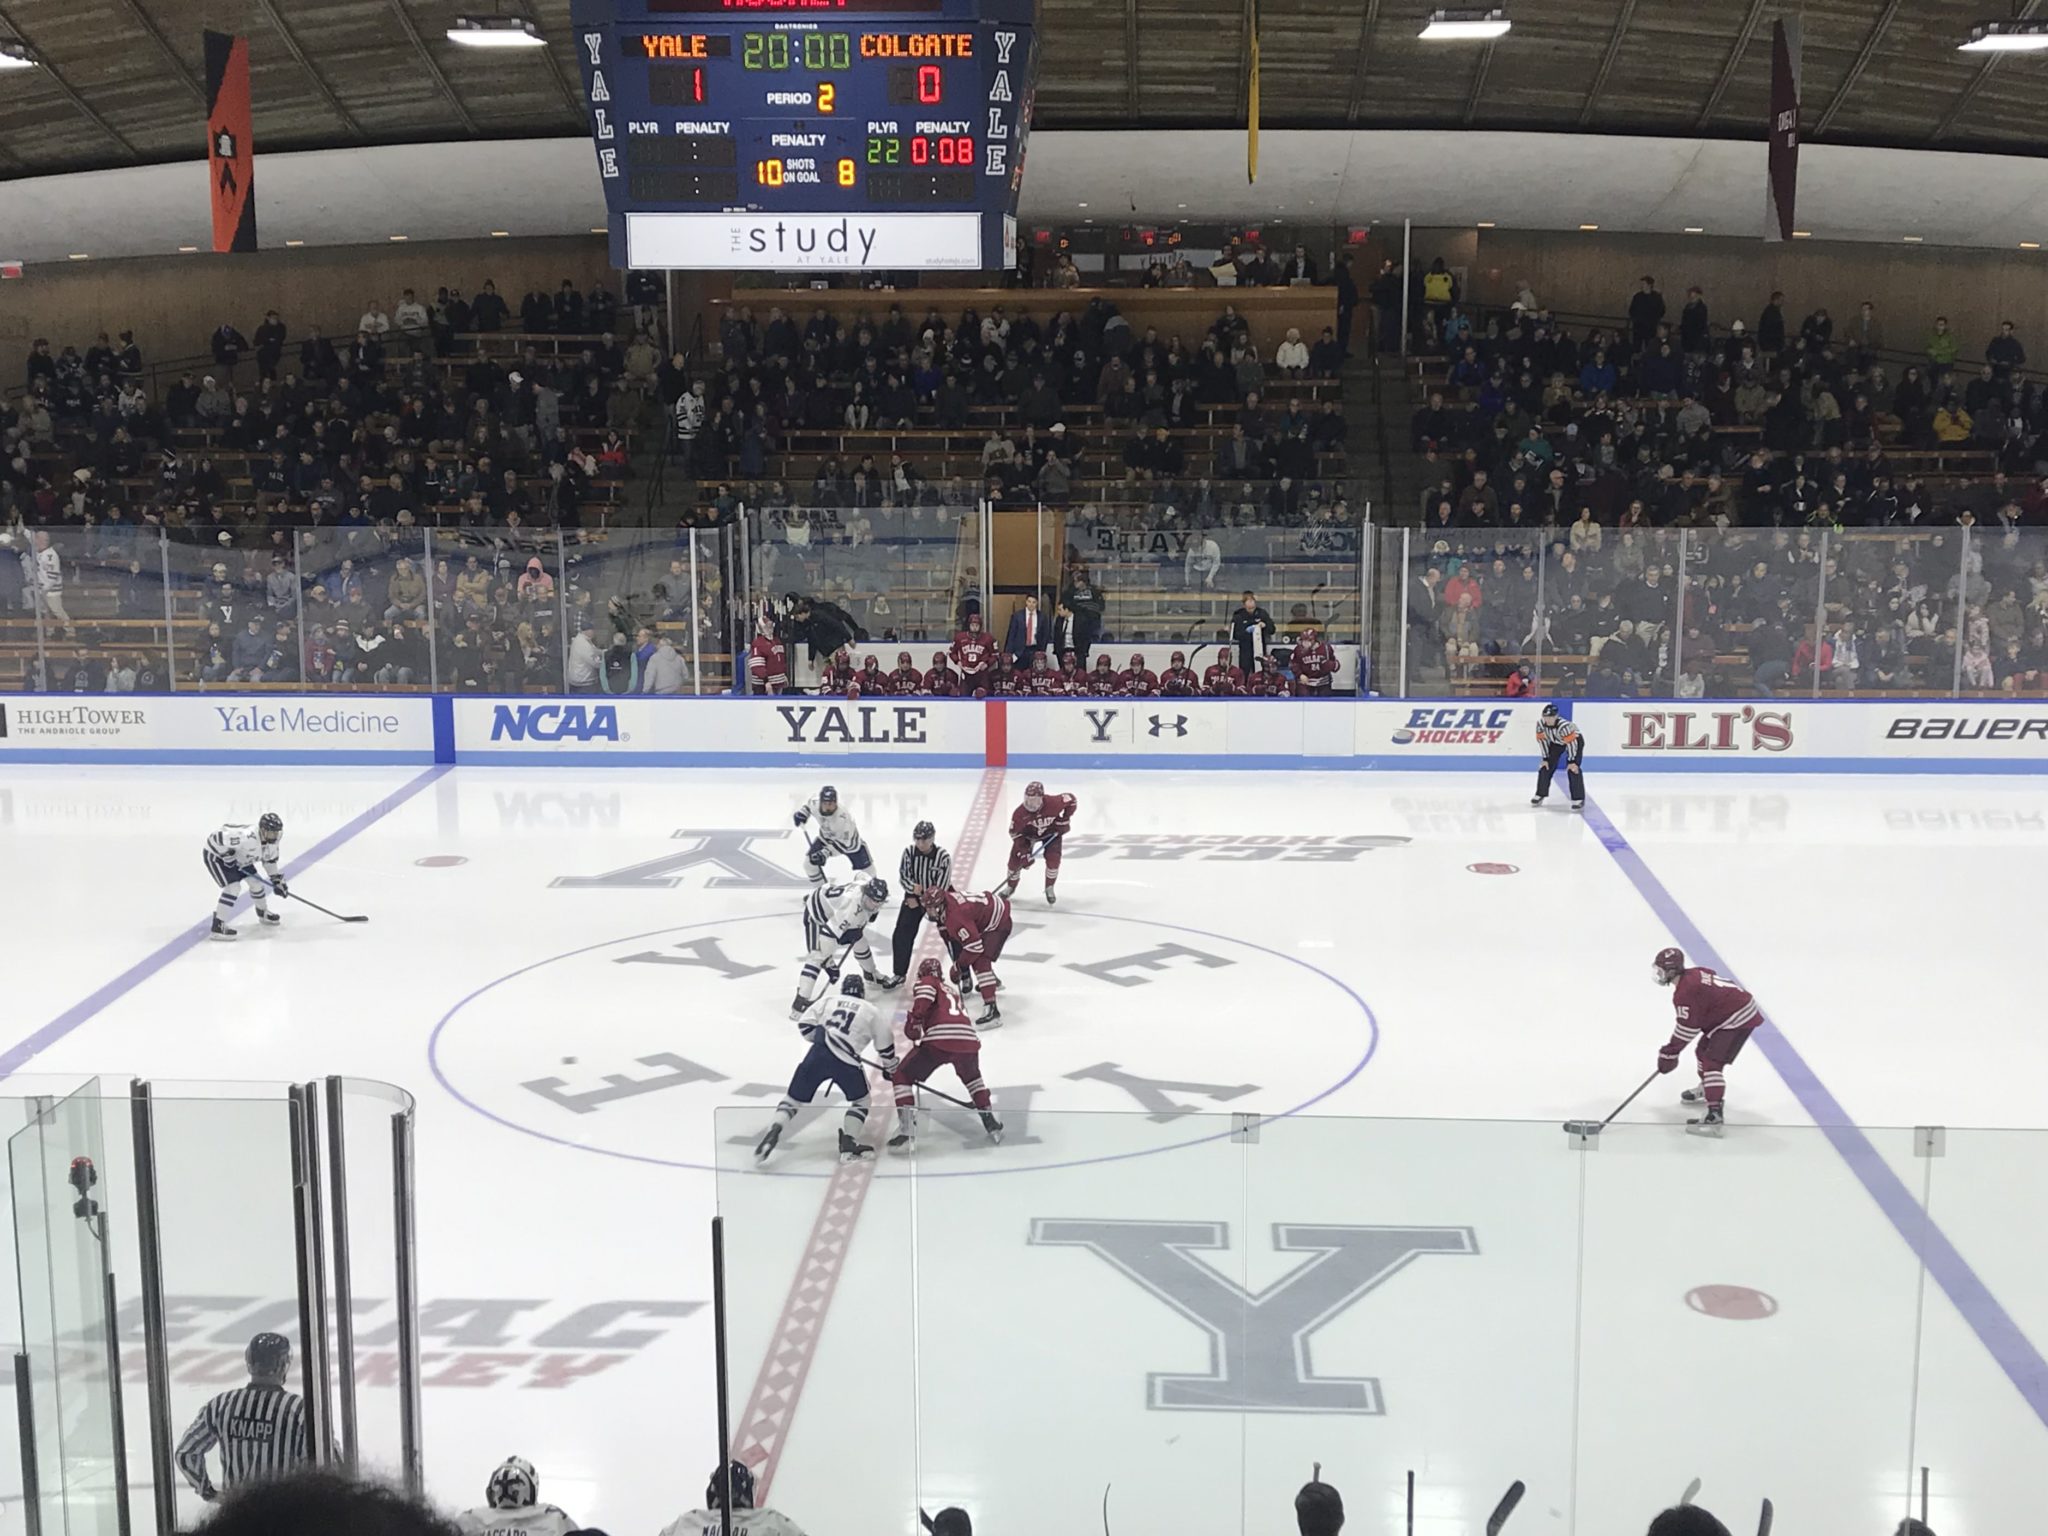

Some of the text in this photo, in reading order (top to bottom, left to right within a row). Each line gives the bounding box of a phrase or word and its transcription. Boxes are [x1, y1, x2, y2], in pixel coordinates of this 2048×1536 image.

[642, 34, 708, 58] YALE
[743, 33, 850, 70] 20:00
[860, 34, 973, 58] COLGATE
[693, 68, 703, 103] 1
[817, 82, 836, 113] 2
[918, 65, 942, 104] 0
[584, 33, 619, 178] YALE
[766, 93, 812, 105] PERIOD
[985, 32, 1016, 176] YALE
[628, 122, 659, 134] PLYR
[675, 122, 731, 134] PENALTY
[771, 134, 826, 147] PENALTY
[867, 121, 898, 134] PLYR
[915, 121, 971, 134] PENALTY
[867, 139, 900, 164] 22
[912, 138, 974, 165] 0:08
[757, 159, 783, 186] 10
[783, 172, 821, 183] ON GOAL
[786, 159, 816, 171] SHOTS
[838, 159, 856, 186] 8
[730, 227, 742, 253] THE
[749, 218, 876, 265] study
[796, 256, 850, 265] AT YALE
[17, 706, 147, 725] HIGHTOWER
[214, 705, 400, 733] Yale Medicine
[490, 705, 619, 741] NCAA
[776, 706, 927, 744] YALE
[1083, 708, 1117, 743] Y
[1405, 709, 1514, 729] ECAC
[1621, 704, 1794, 751] ELI'S
[1415, 730, 1504, 744] HOCKEY
[825, 1008, 858, 1036] 21
[1676, 1005, 1690, 1020] 15
[1025, 1217, 1482, 1415] Y
[229, 1418, 274, 1440] KNAPP
